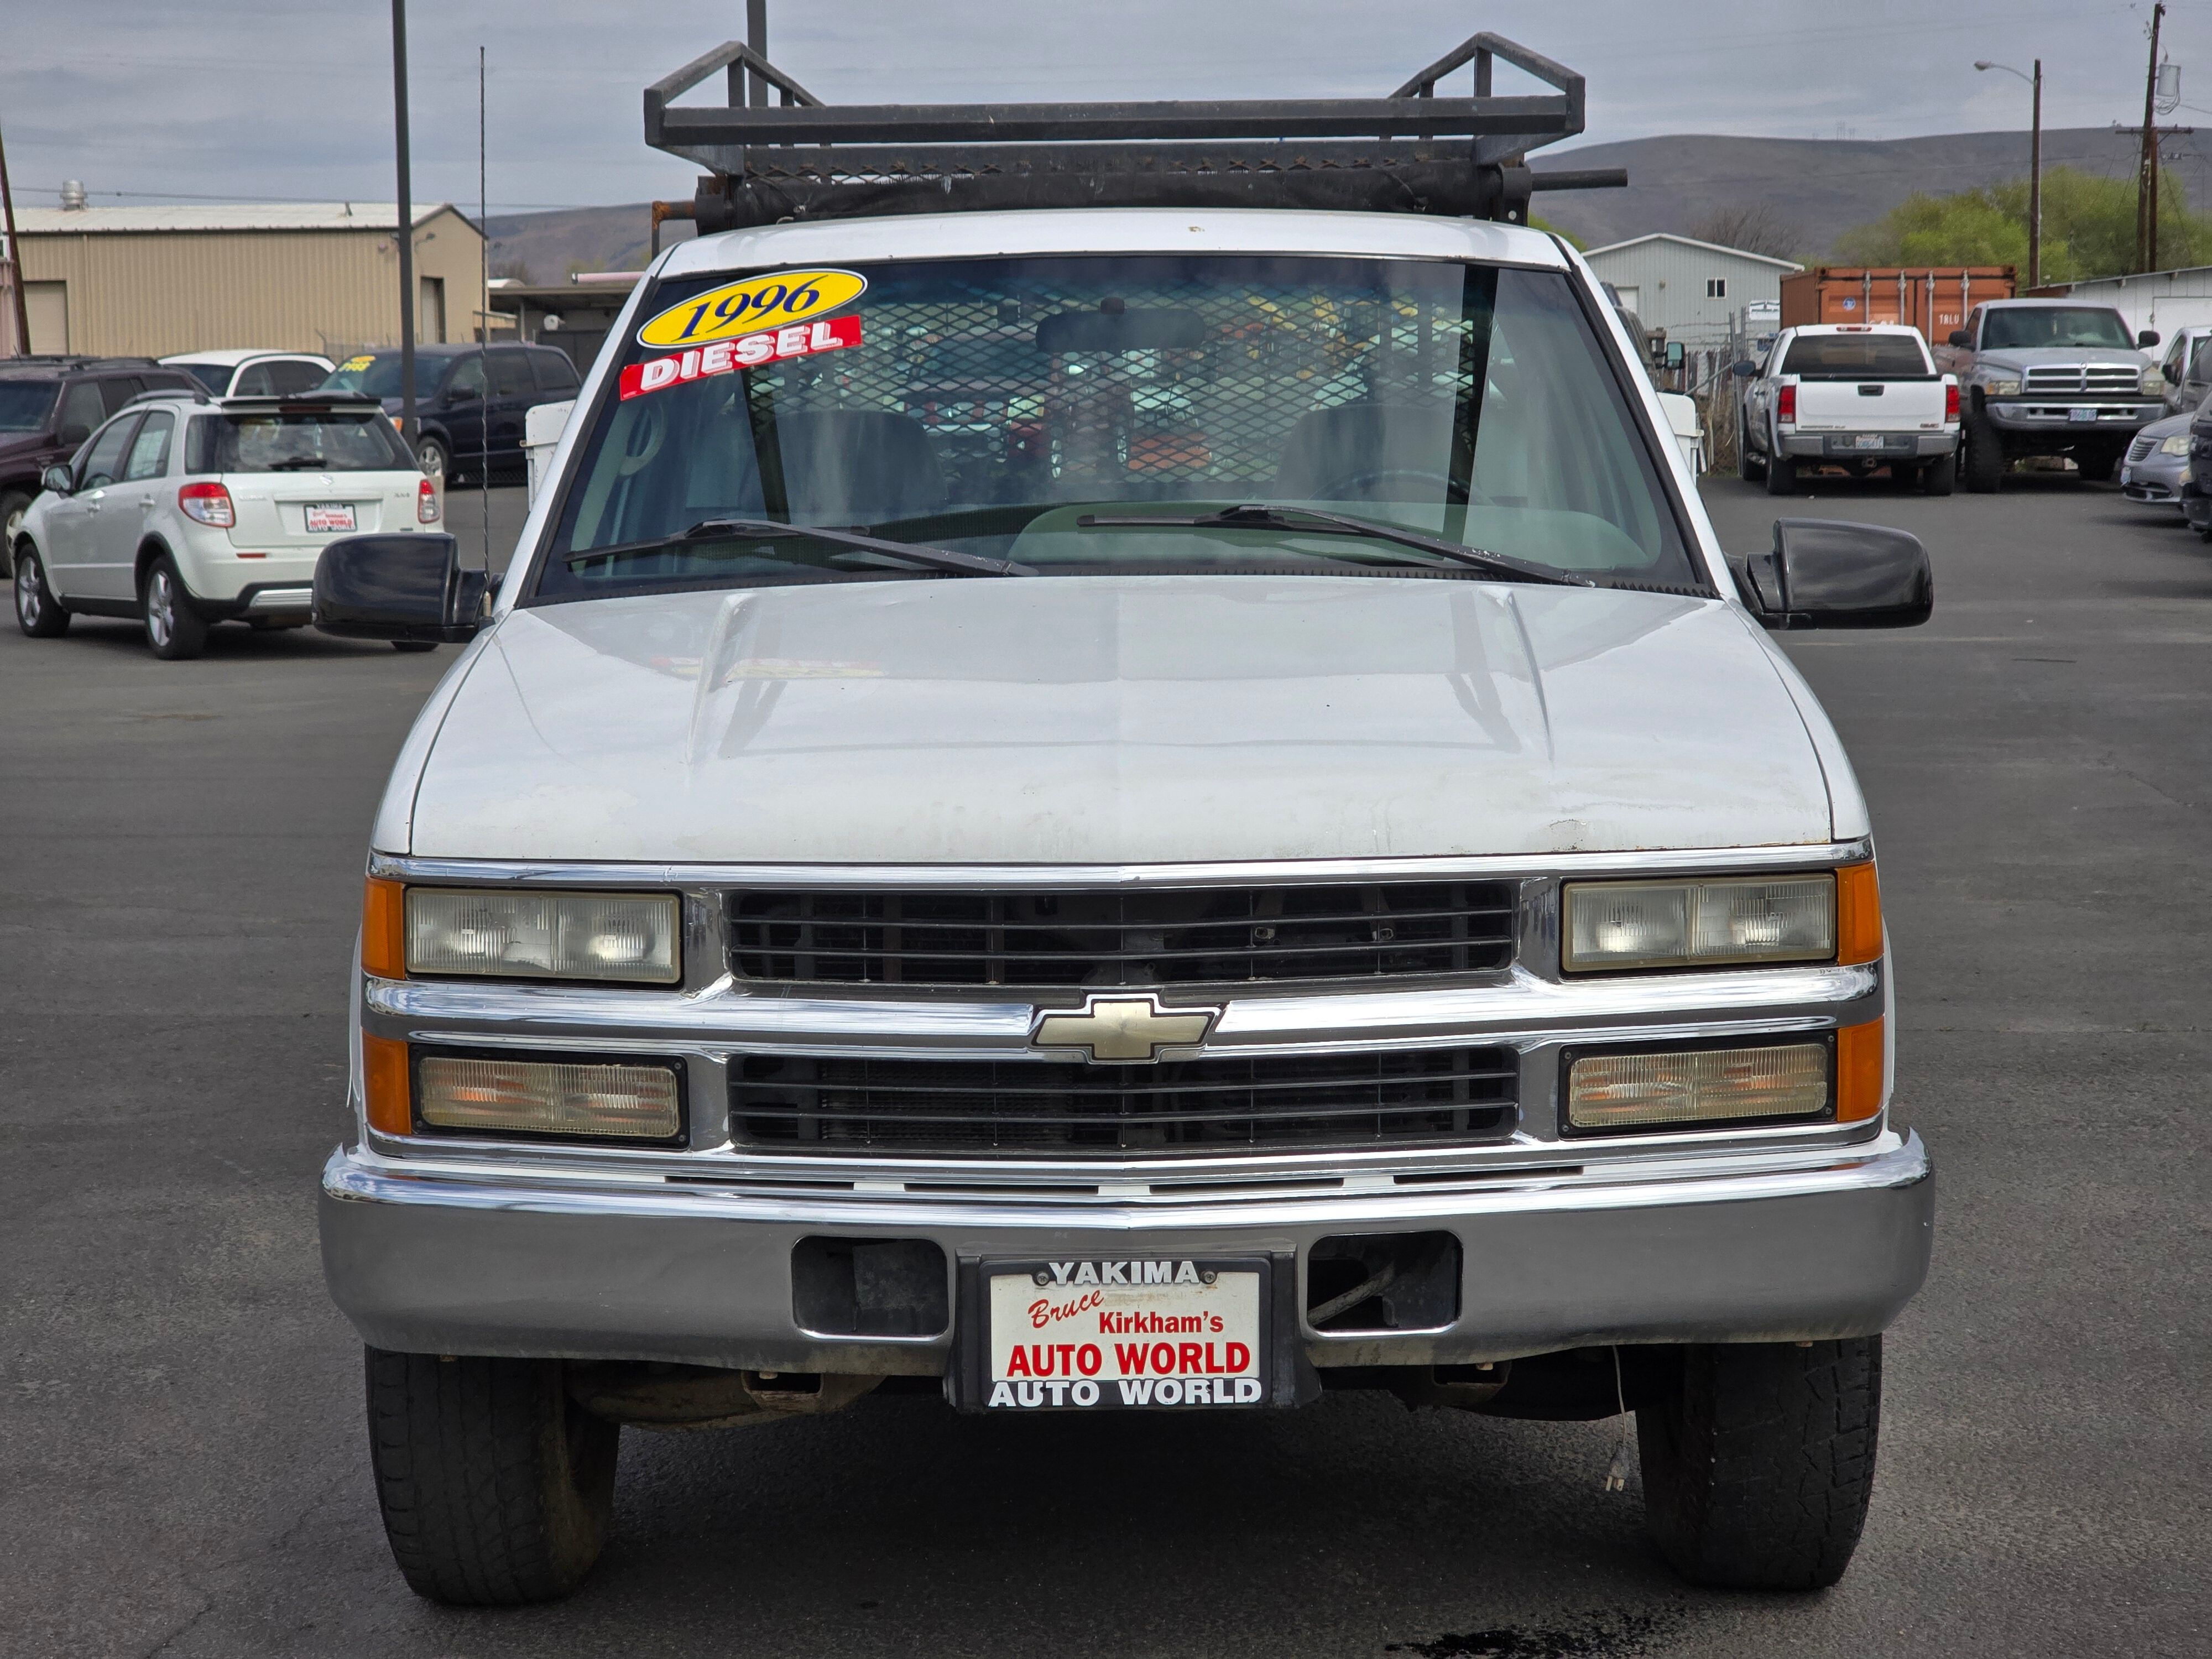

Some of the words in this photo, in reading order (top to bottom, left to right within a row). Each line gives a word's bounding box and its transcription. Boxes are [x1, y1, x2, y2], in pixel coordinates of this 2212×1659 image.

[671, 275, 829, 342] 1996
[640, 321, 843, 390] DIESEL
[1049, 1260, 1201, 1285] YAKIMA
[1027, 1290, 1104, 1328] Bruce
[1099, 1311, 1224, 1334] Kirkham's
[1006, 1343, 1102, 1377] AUTO
[1115, 1342, 1251, 1375] WORLD
[988, 1380, 1100, 1407] AUTO
[1118, 1378, 1262, 1405] WORLD
